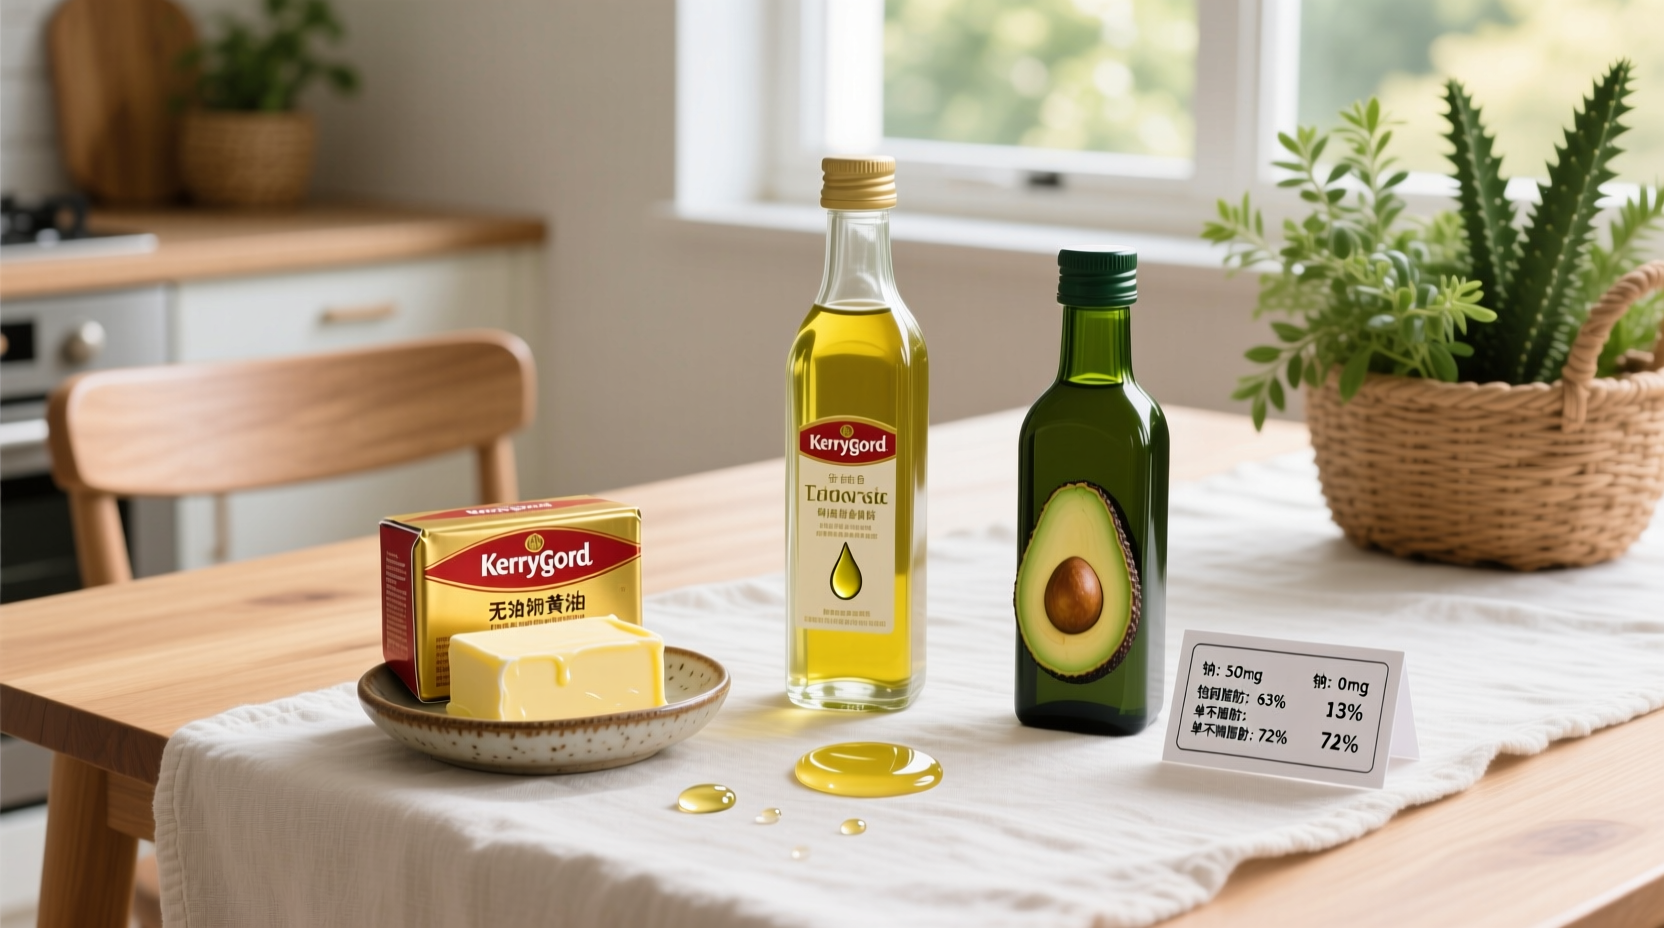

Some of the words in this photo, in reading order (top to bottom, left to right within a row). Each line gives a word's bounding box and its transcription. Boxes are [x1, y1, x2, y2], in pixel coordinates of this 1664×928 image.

[481, 541, 593, 579] KerryGord
[1225, 664, 1263, 685] 50mg
[1338, 677, 1370, 697] 0mg
[1257, 693, 1286, 709] 63%
[1326, 701, 1363, 722] 13%
[1258, 728, 1288, 745] 72%
[1320, 731, 1359, 754] 72%
